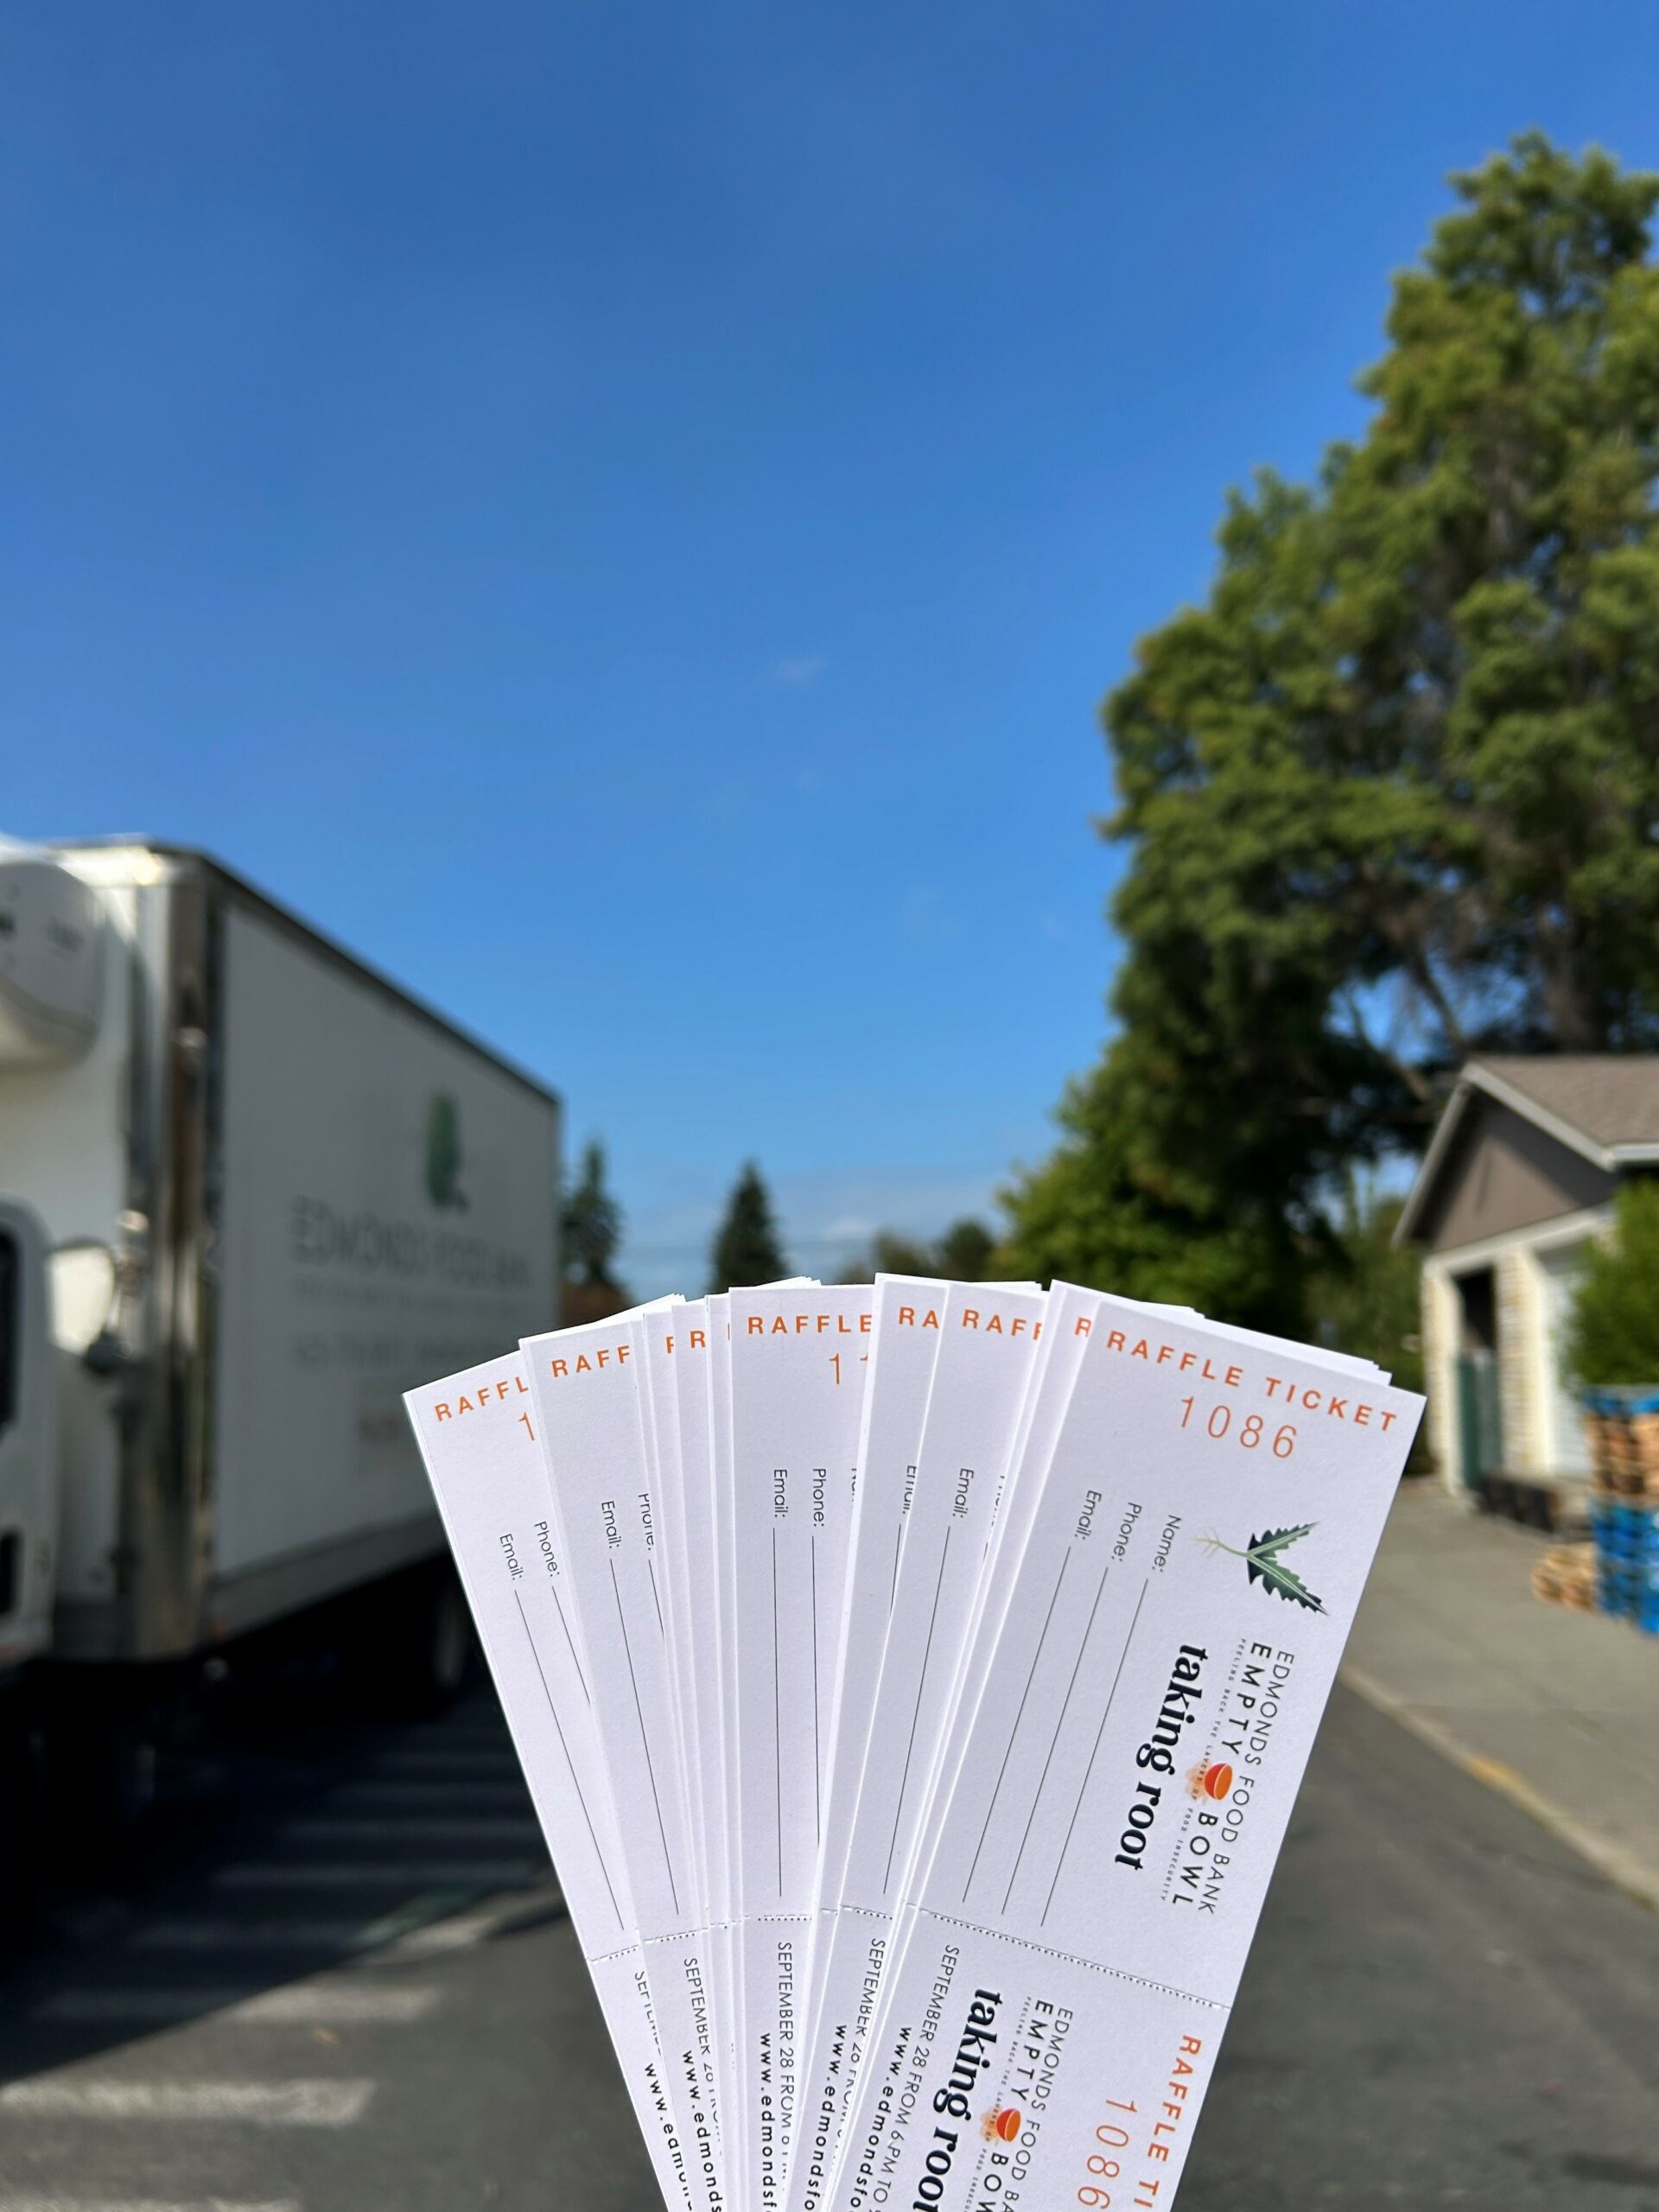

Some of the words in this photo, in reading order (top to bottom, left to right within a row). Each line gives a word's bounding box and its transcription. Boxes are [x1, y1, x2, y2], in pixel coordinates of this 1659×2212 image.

[748, 1315, 872, 1334] RAFFLE
[1107, 1331, 1243, 1387] RAFFLE
[1267, 1377, 1396, 1431] TICKET
[1182, 1397, 1296, 1458] 1086
[774, 1470, 788, 1517] Email:
[813, 1469, 826, 1527] Phone:
[952, 1468, 974, 1518] Email:
[1075, 1491, 1102, 1540] Email:
[534, 1521, 560, 1577] Phone:
[601, 1501, 621, 1548] Email:
[1111, 1503, 1142, 1562] Phone:
[1152, 1515, 1181, 1572] Name:
[499, 1534, 524, 1580] Email:
[1135, 1644, 1208, 1776] taking
[1222, 1643, 1272, 1755] EMPTY
[1244, 1651, 1294, 1765] EDMONDS
[1115, 1781, 1161, 1871] root
[1221, 1776, 1255, 1842] FOOD
[1173, 1812, 1218, 1904] BOWL
[1198, 1853, 1230, 1914] BANK
[778, 1942, 793, 2040] SEPTEMBER
[919, 1945, 959, 2042] SEPTEMBER
[780, 2047, 794, 2069] 28
[912, 2046, 930, 2068] 28
[933, 1989, 1002, 2121] taking
[1011, 2000, 1053, 2101] EMPTY
[1031, 2008, 1073, 2111] EDMONDS
[760, 2033, 777, 2212] www.edmondsf
[781, 2075, 794, 2128] FROM
[895, 2072, 922, 2125] FROM
[1147, 2036, 1202, 2161] RAFFLE
[1012, 2120, 1040, 2181] FOOD
[1077, 2101, 1137, 2209] 1086
[874, 2180, 891, 2203] TO
